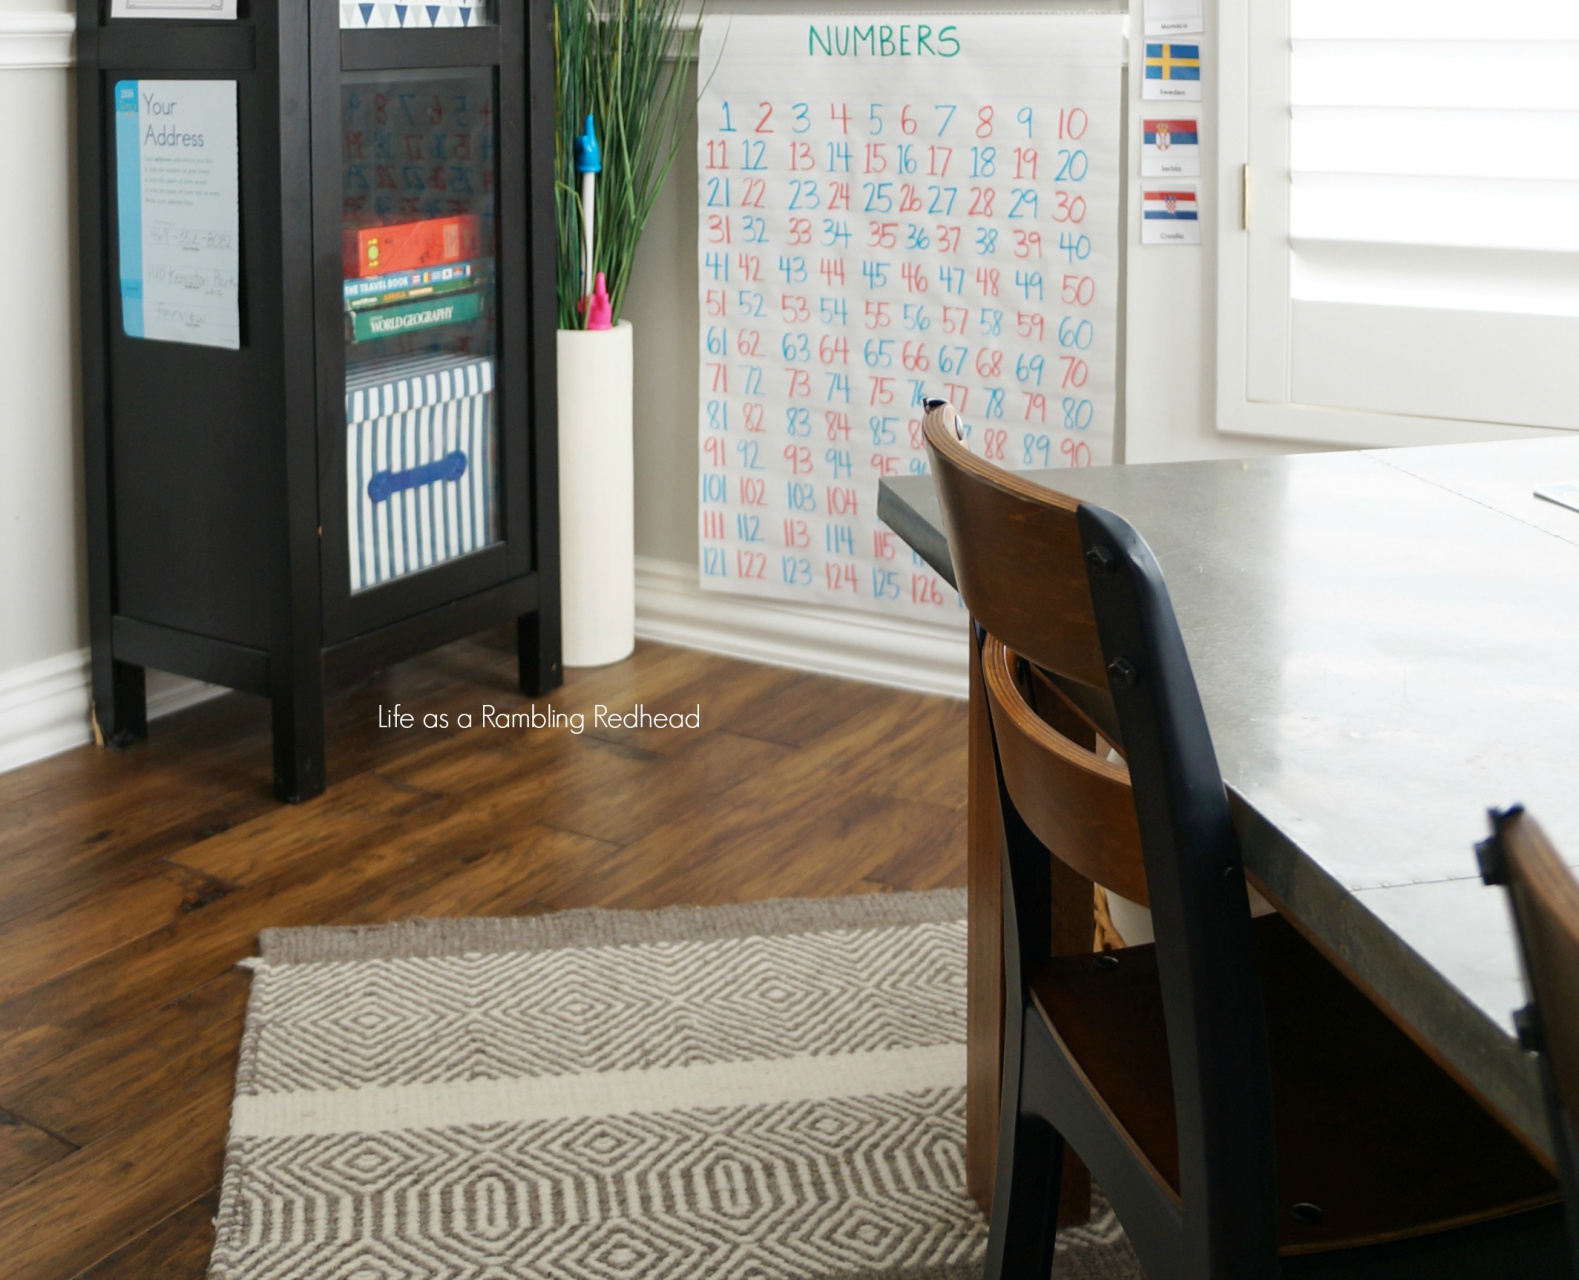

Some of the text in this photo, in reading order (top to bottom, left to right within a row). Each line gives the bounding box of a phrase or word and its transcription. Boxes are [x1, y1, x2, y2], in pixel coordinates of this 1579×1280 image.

[808, 24, 961, 57] NUMBERS
[142, 92, 177, 116] Your
[718, 100, 1089, 141] 1 2 3 4 5 6 7 8 9 10
[143, 123, 205, 148] Address
[706, 138, 1089, 183] 11 12 13 14 15 16 17 18 19 20
[706, 175, 1087, 225] 21 22 23 24 25 26 27 28 29 30
[708, 213, 1092, 262] 31 32 33 34 35 36 37 38 39 40
[344, 276, 409, 296] THE TRAVEL BOOK
[704, 251, 1096, 307] 41 42 43 44 45 46 47 48 49 50
[370, 305, 454, 333] WORLD GEOGRAPHY
[705, 289, 1093, 349] 51 52 53 54 55 56 57 58 59 60
[705, 326, 1090, 390] 61 62 63 64 65 66 67 68 69 70
[706, 363, 1093, 430] 71 72 73 74 75 77 78 79 80
